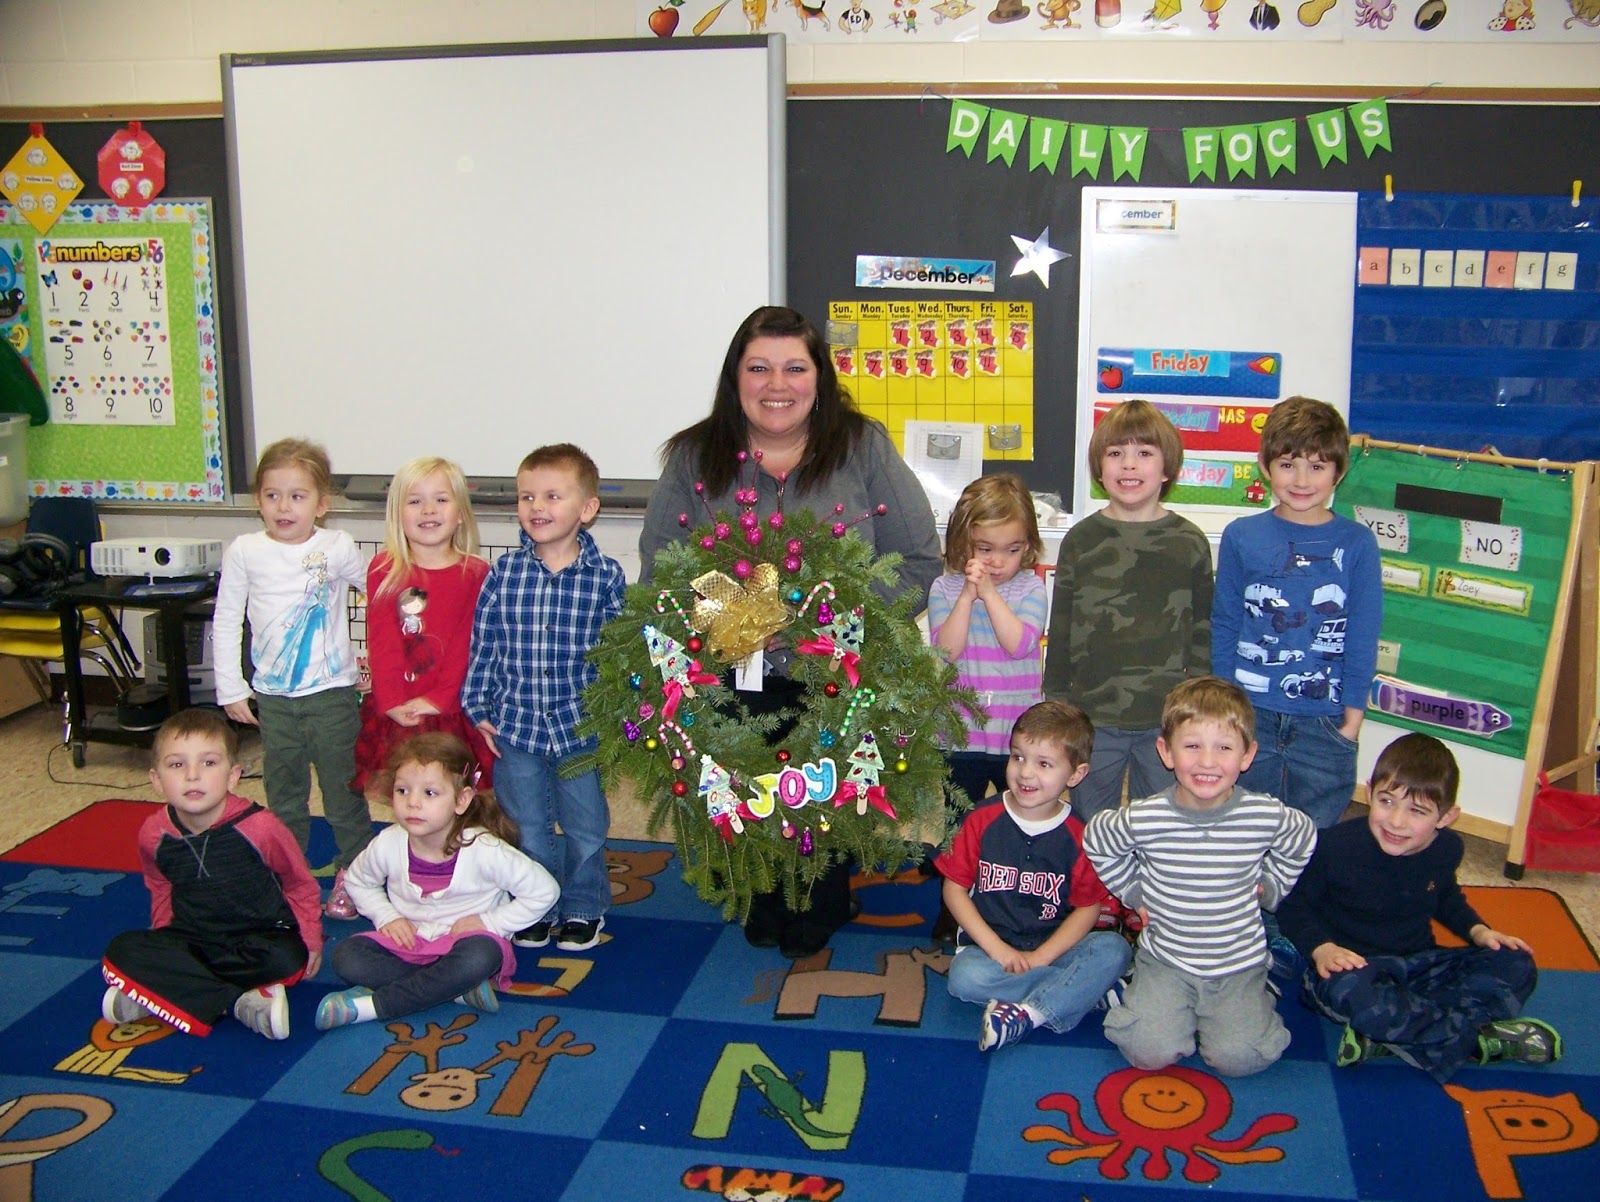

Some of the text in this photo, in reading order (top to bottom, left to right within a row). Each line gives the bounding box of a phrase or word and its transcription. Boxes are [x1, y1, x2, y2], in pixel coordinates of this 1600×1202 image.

[850, 14, 862, 24] ED
[952, 107, 1385, 164] DAILY FOCUS
[1121, 209, 1164, 219] cember
[55, 241, 142, 264] numbers
[879, 264, 976, 285] December
[1369, 262, 1567, 277] a b c d e f g
[51, 291, 159, 307] 1 2 3 4
[833, 303, 1028, 314] Sun. Mon. Tues. Wed. Thurs. Fri. Sat.
[899, 329, 1021, 343] 1 2 3 4 5
[64, 344, 154, 361] 5 6 7
[840, 356, 991, 372] 6 7 8 9 10 11
[1151, 351, 1209, 374] Friday
[65, 396, 163, 414] 8 9 10
[1233, 464, 1252, 480] BE
[1365, 519, 1398, 539] YES
[1476, 537, 1503, 556] NO
[1457, 578, 1481, 597] Zoey
[1411, 699, 1465, 721] purple
[747, 757, 838, 818] JOY
[978, 860, 1065, 906] RED SOX
[1038, 903, 1058, 921] B
